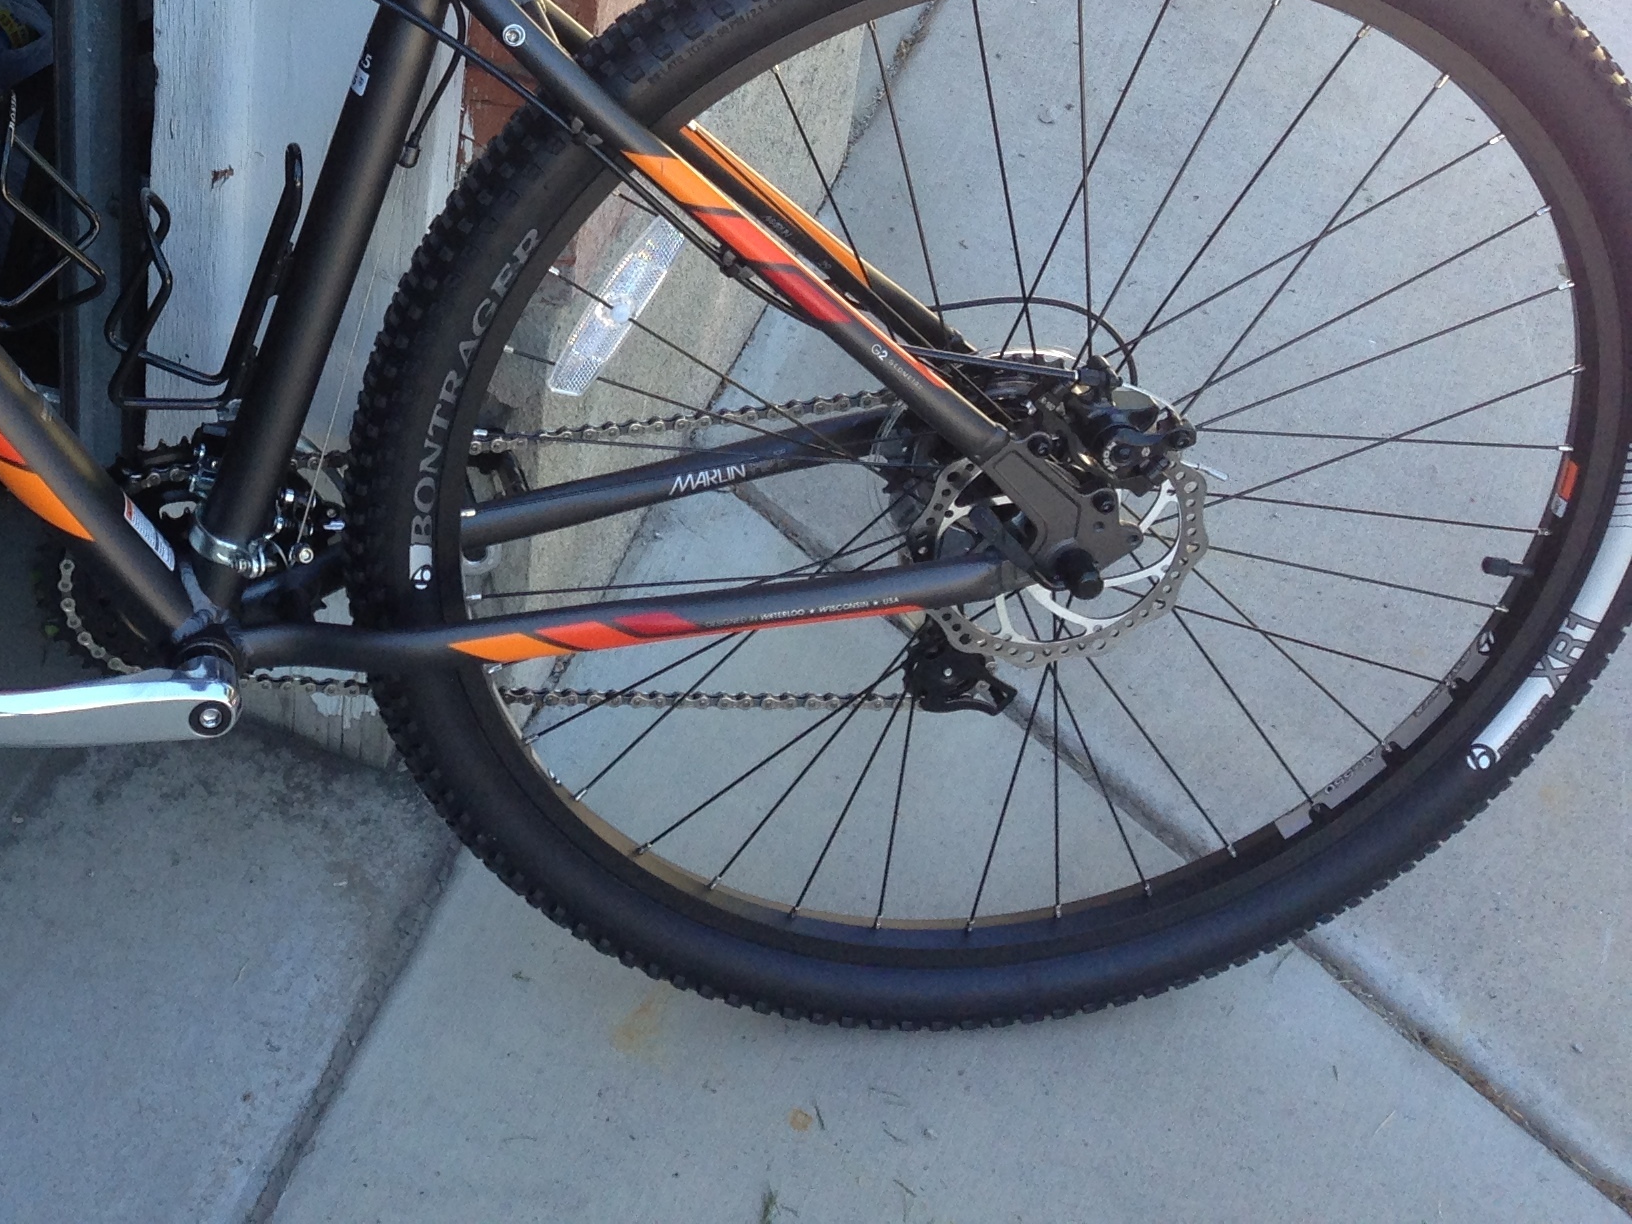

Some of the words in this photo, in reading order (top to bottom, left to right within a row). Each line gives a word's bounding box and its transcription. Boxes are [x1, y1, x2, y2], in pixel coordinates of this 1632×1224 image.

[871, 344, 889, 361] G2
[410, 228, 542, 545] BONTRAGER
[669, 464, 746, 496] MARLIN
[760, 607, 805, 622] WATERLOO
[819, 600, 869, 614] WISCONSIN
[882, 596, 900, 606] USA
[1528, 612, 1602, 692] XR1
